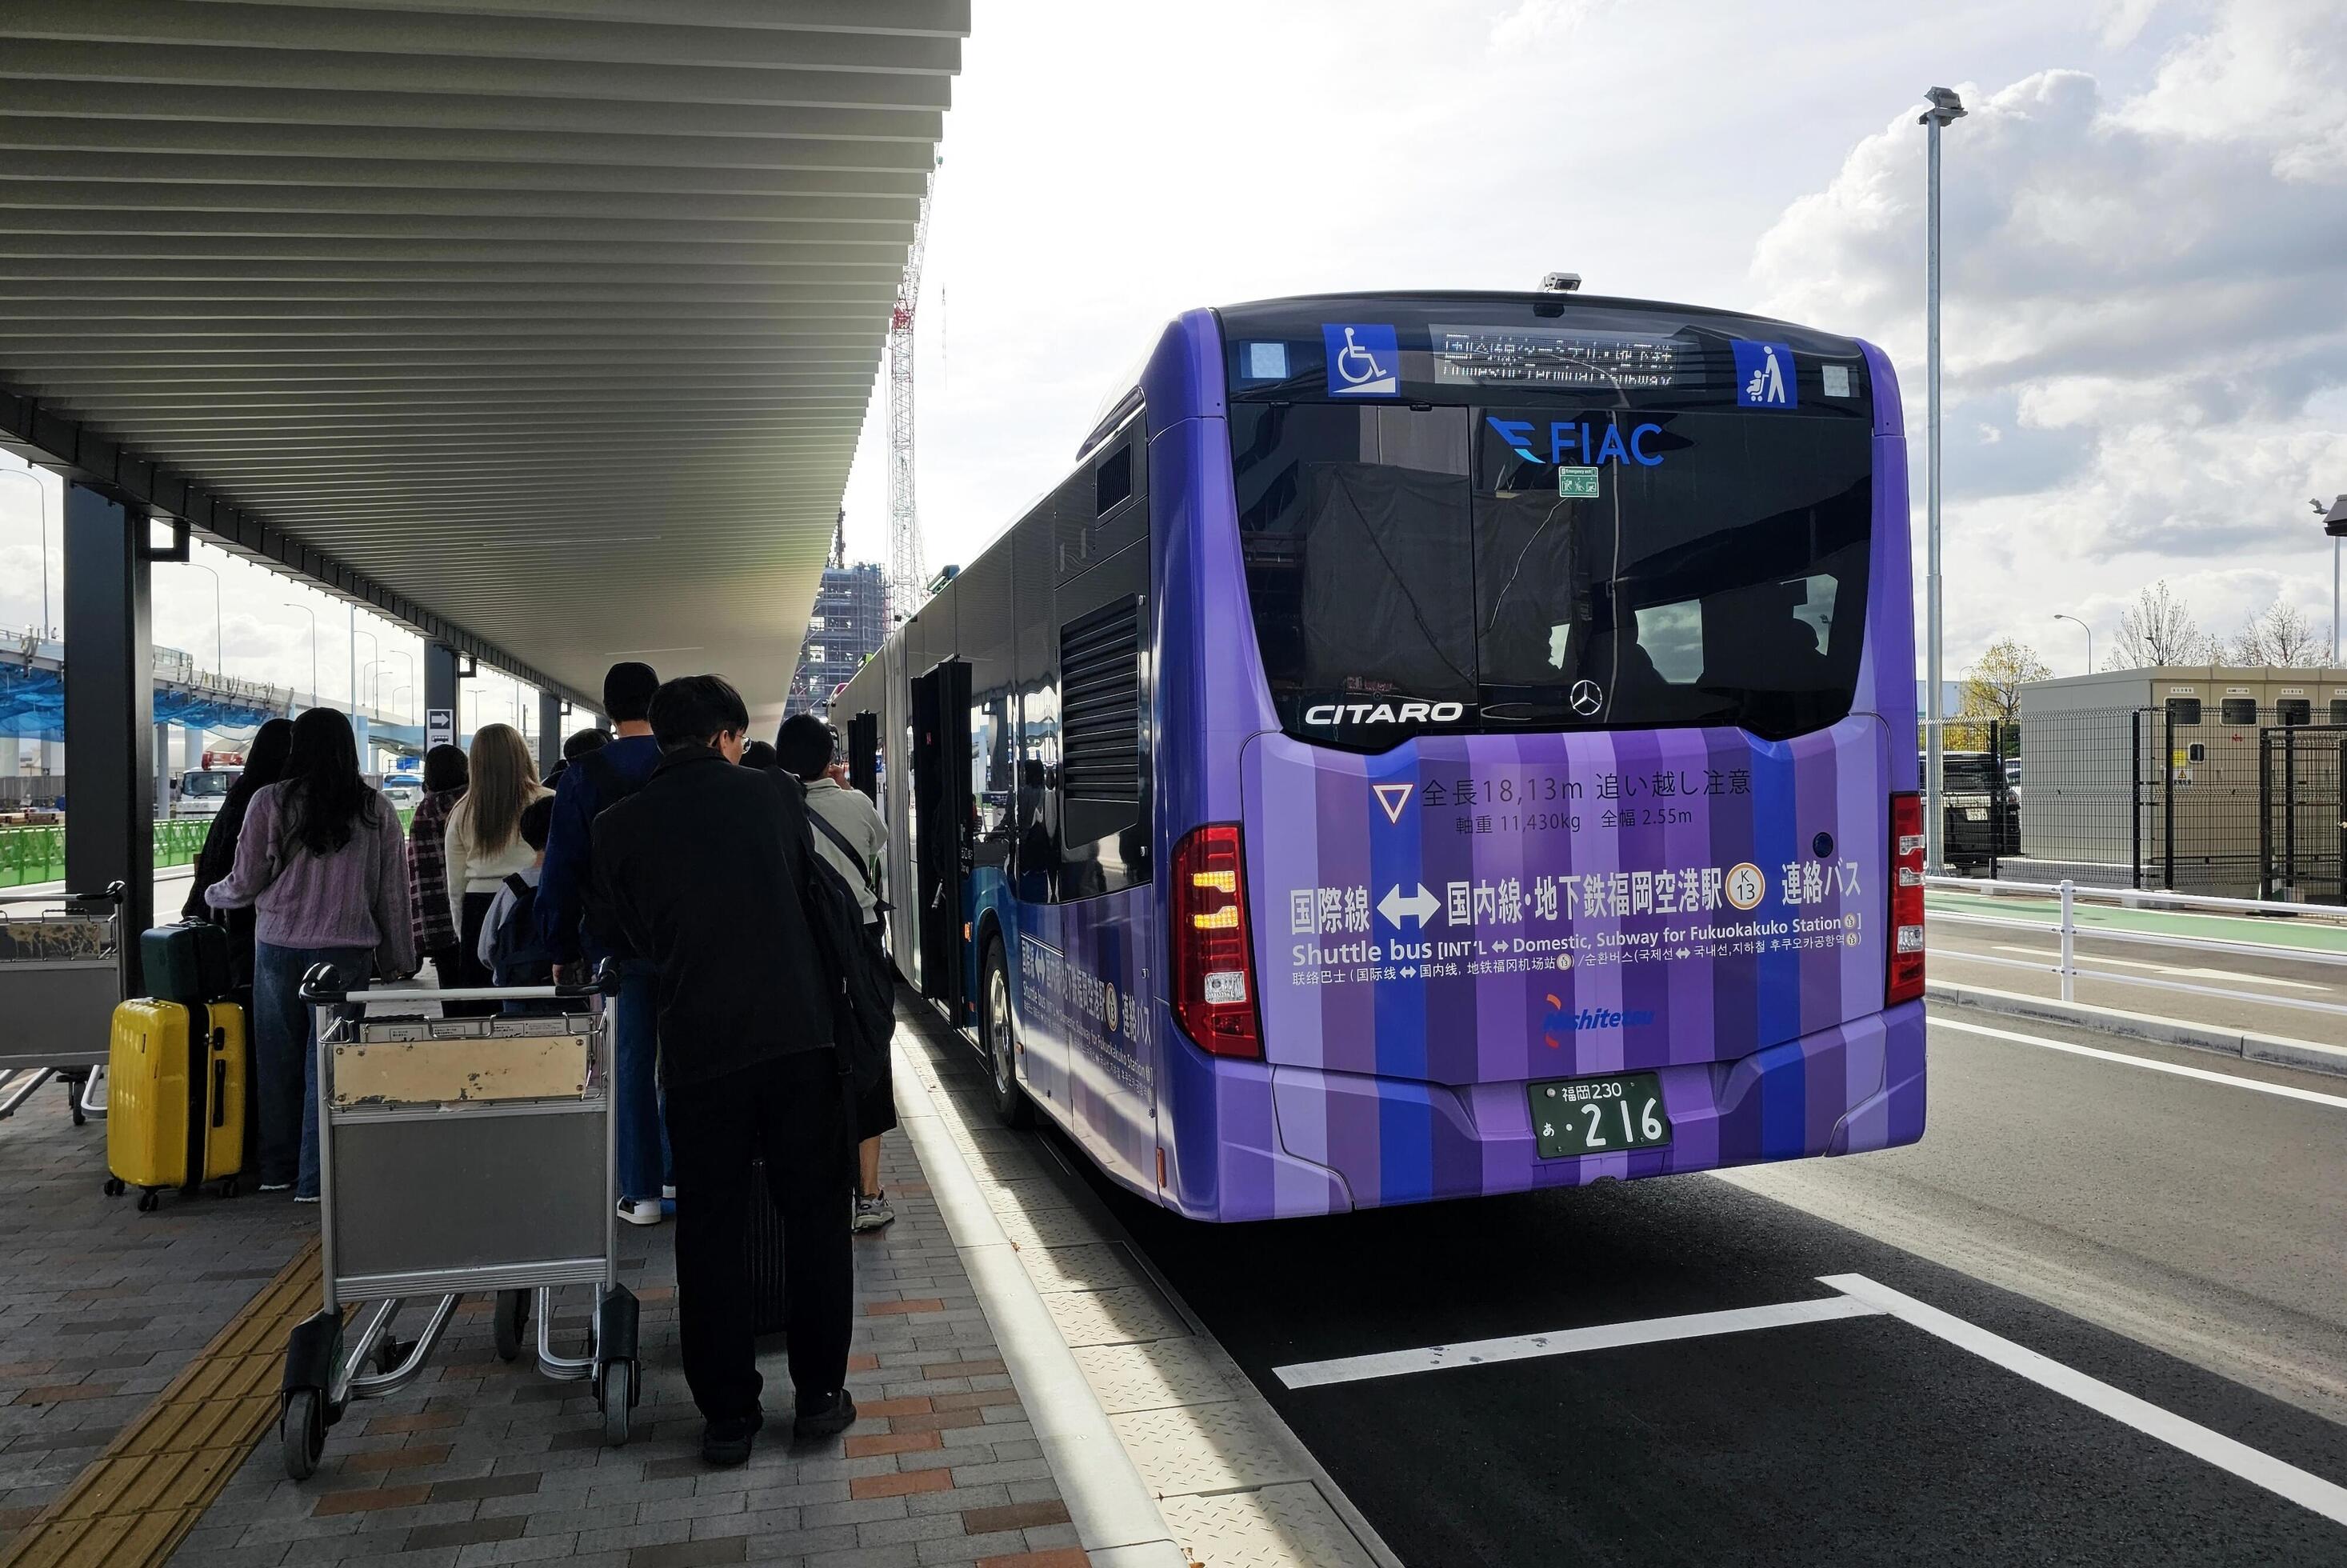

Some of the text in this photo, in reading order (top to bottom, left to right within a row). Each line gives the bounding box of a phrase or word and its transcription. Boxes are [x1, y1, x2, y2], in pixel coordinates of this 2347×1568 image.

[1550, 422, 1665, 466] FIAC
[1305, 702, 1464, 725] CITARO
[1596, 768, 1752, 800] 追い越し注意
[1455, 808, 1692, 835] 軸重 11,430kg 全幅 2.55m
[1741, 870, 1749, 882] K
[1290, 884, 1370, 935] 国際線
[1781, 859, 1861, 906] 連絡バス
[1737, 885, 1756, 901] 13
[1293, 939, 1381, 966] Shuttle
[1390, 938, 1432, 961] bus
[1513, 932, 1592, 953] Domestic,
[1597, 928, 1659, 948] Subway
[1663, 927, 1685, 942] for
[1690, 921, 1789, 941] Fukuokakuko
[1792, 916, 1841, 934] Station
[1542, 1122, 1555, 1137] あ
